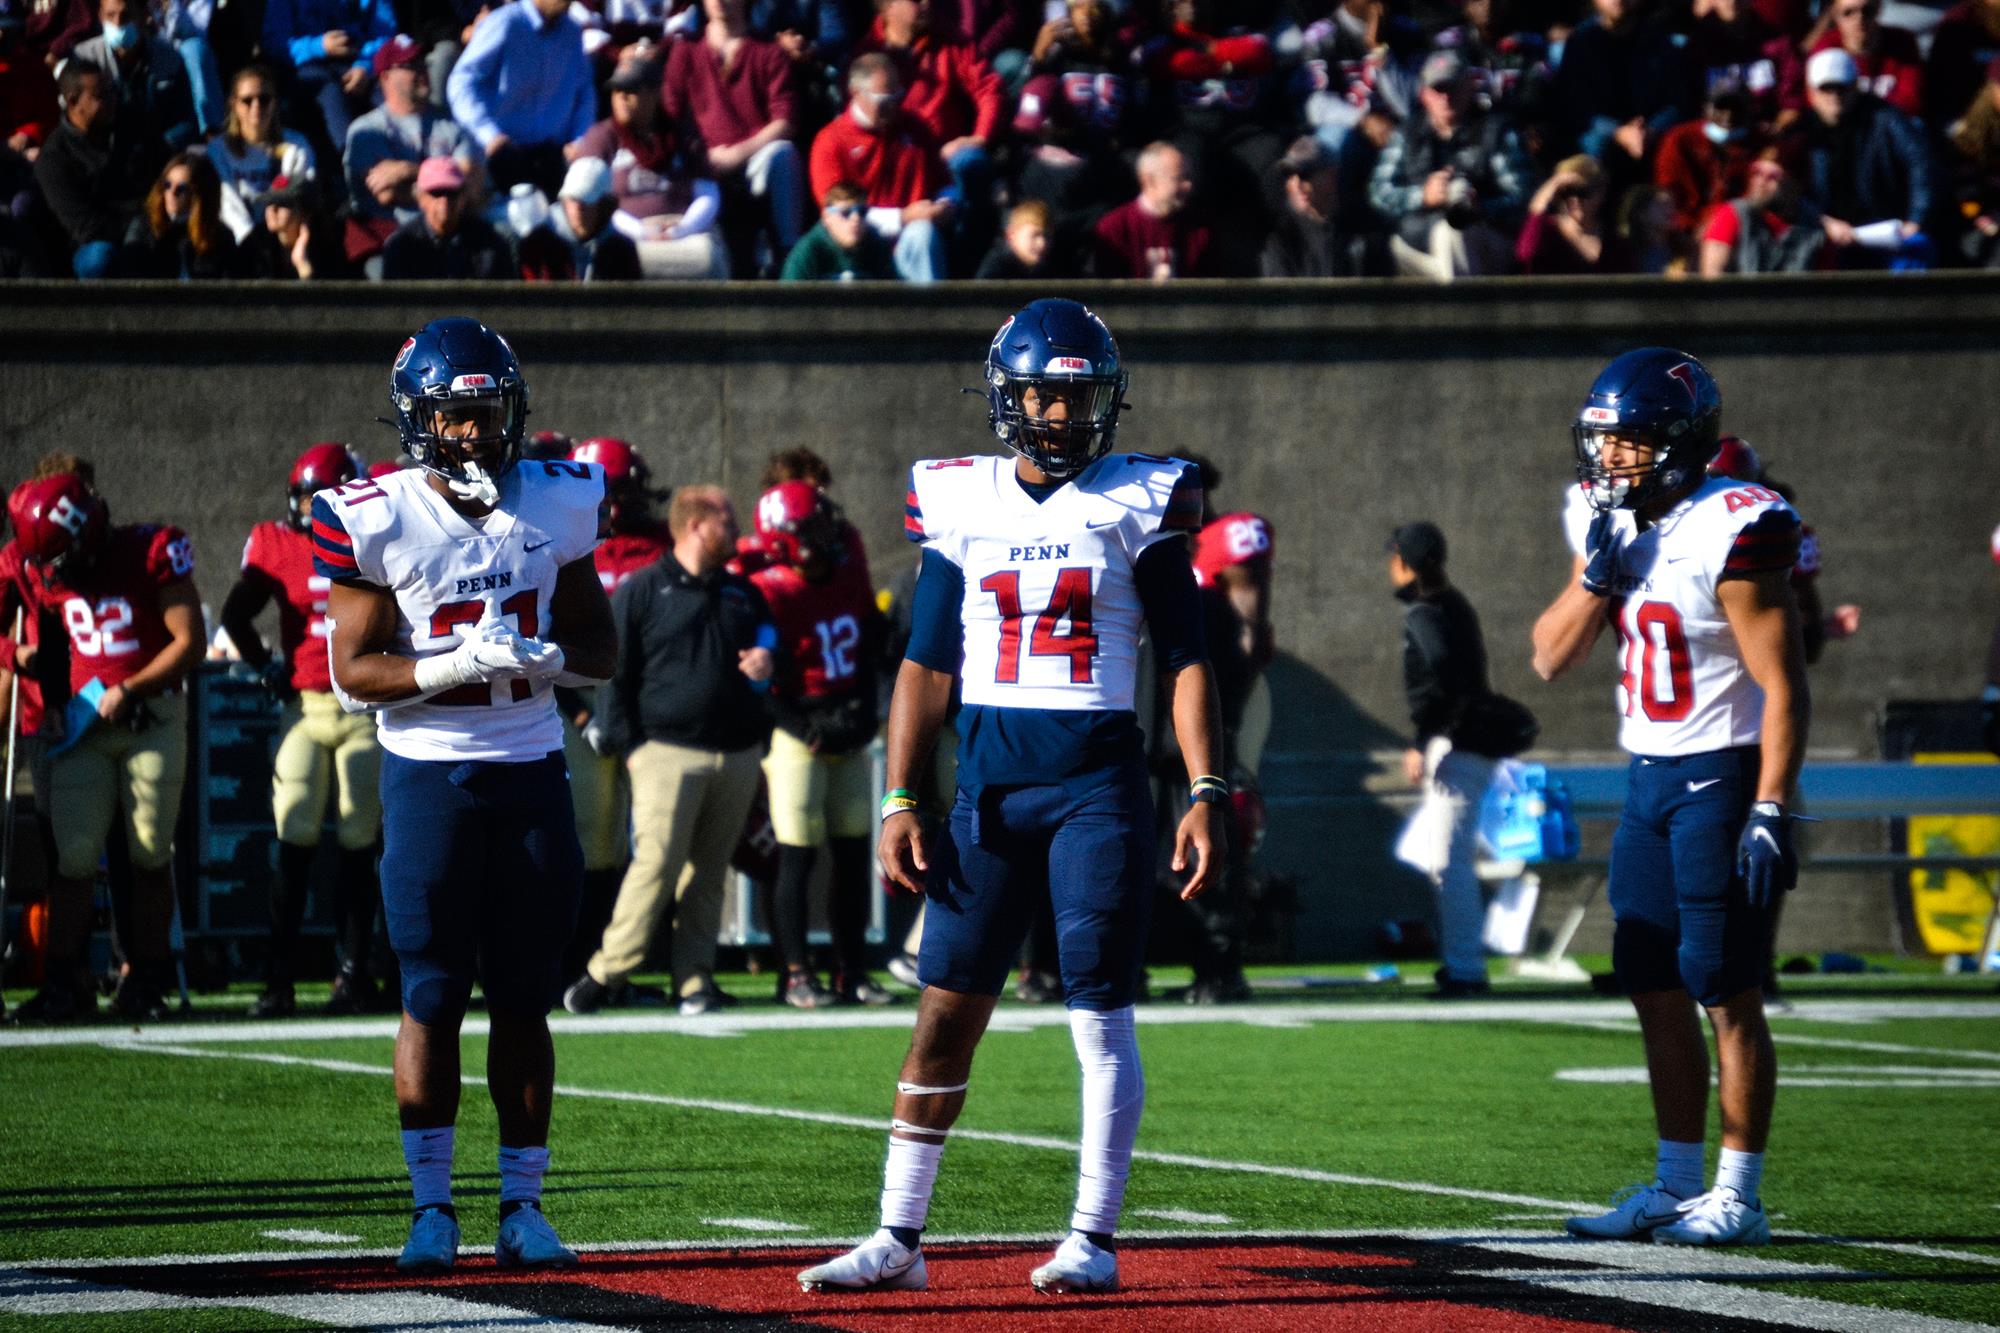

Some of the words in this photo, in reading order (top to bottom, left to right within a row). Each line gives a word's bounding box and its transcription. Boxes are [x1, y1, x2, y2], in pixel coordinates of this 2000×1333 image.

[1060, 358, 1084, 369] PENN
[462, 374, 486, 387] PENN
[1723, 486, 1784, 514] 40
[48, 494, 88, 536] H
[1008, 543, 1071, 562] PENN
[455, 571, 513, 594] PENN
[980, 566, 1100, 684] 14
[815, 614, 860, 681] 12
